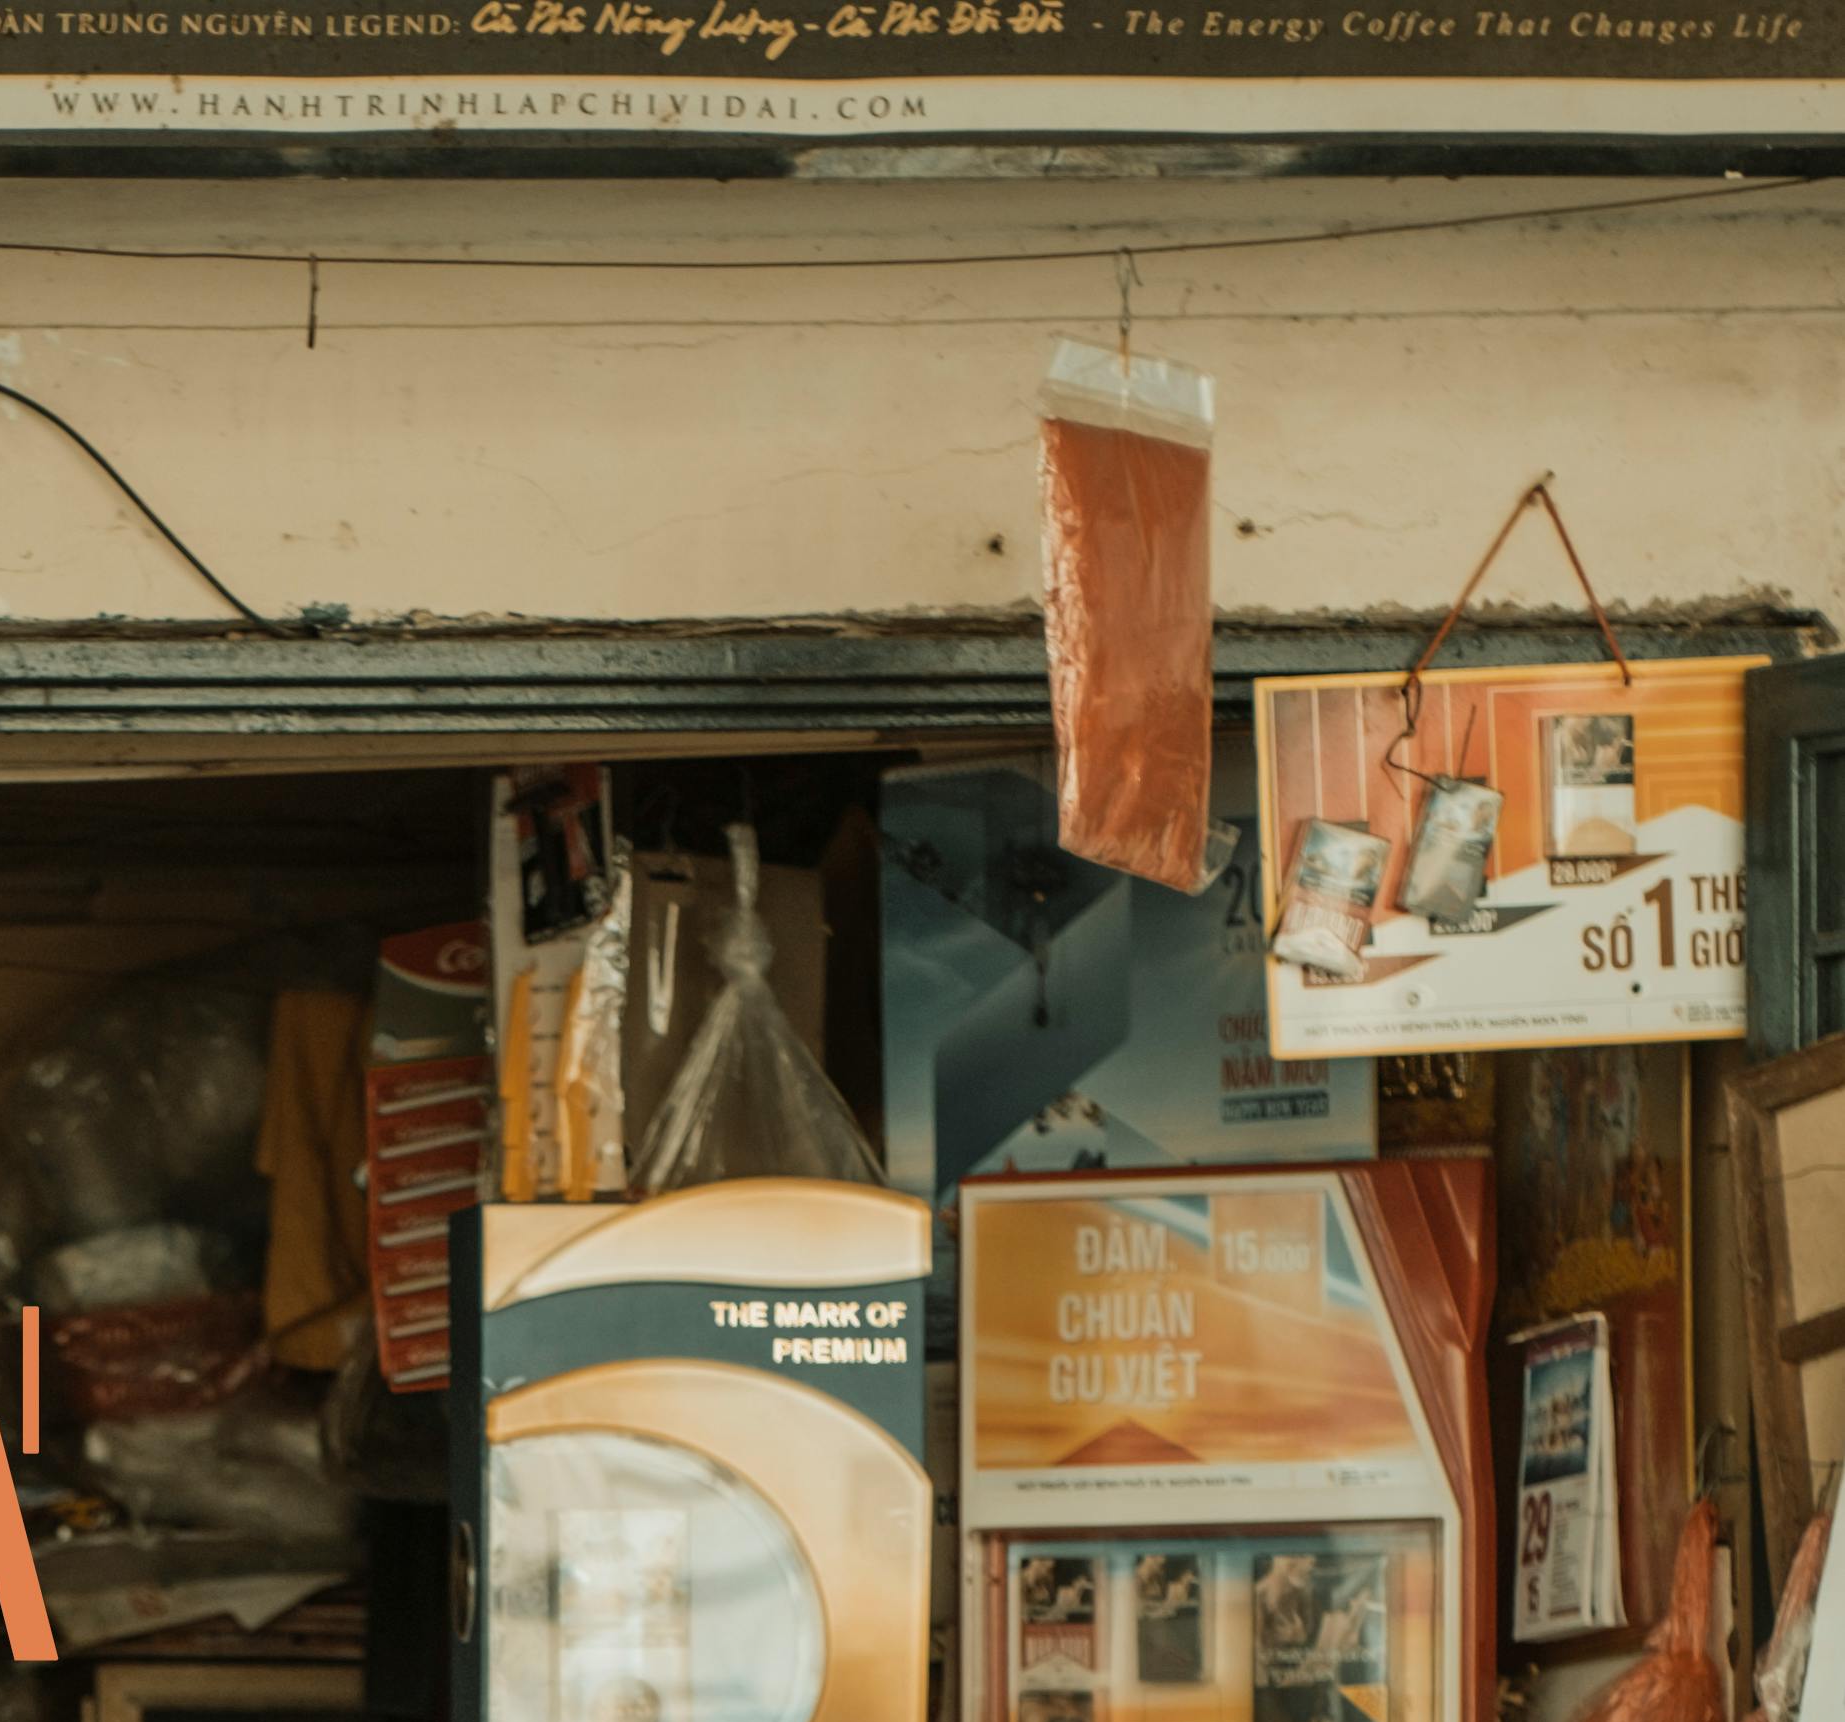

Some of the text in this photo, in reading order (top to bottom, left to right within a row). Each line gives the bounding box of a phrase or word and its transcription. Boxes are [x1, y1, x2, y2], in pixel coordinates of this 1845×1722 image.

[56, 12, 167, 36] TRUNG
[181, 11, 312, 37] NGUYÊN
[326, 15, 462, 38] LEGEND:
[1126, 11, 1185, 36] The
[1203, 14, 1324, 43] Energy
[1343, 12, 1457, 40] Coffee
[1475, 11, 1552, 37] That
[1570, 12, 1714, 44] Changes
[1734, 12, 1802, 40] Life
[1581, 877, 1676, 972] SỐ 1
[1690, 919, 1747, 968] GIỚ
[709, 1301, 908, 1328] THE MARK OF
[771, 1337, 908, 1364] PREMIUM
